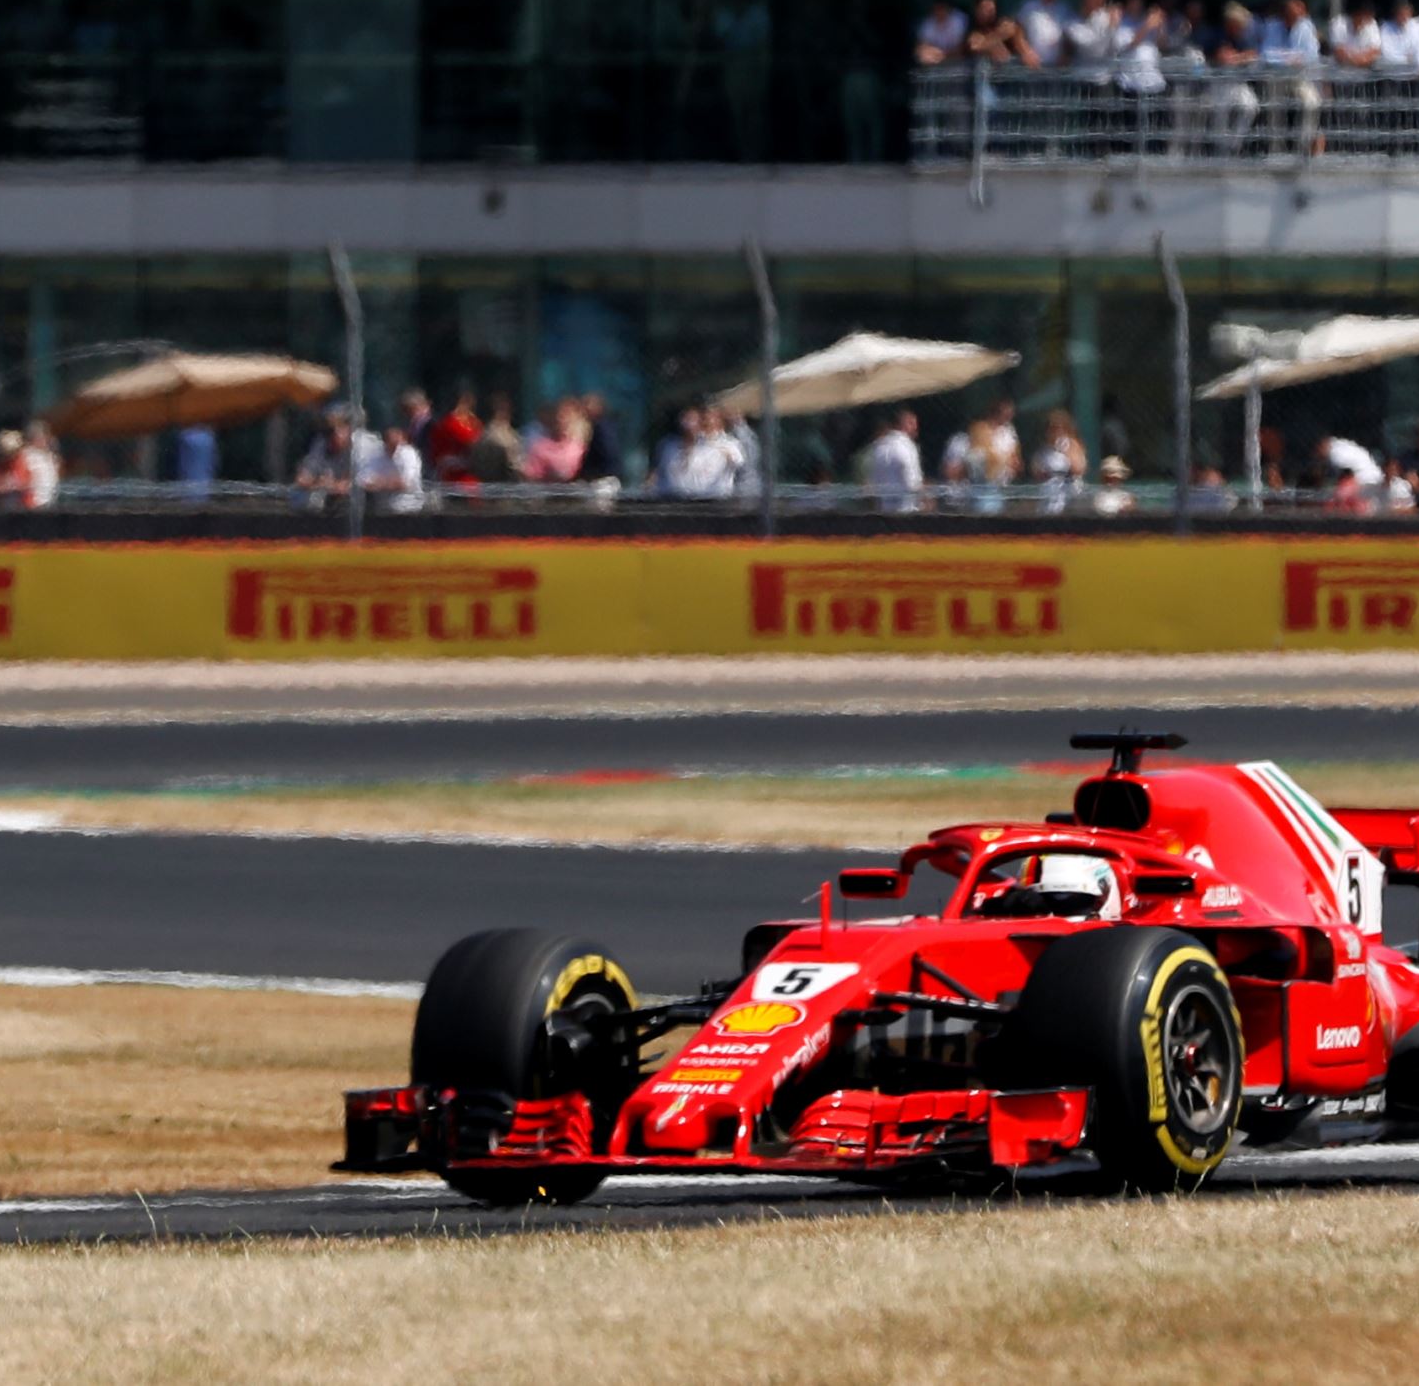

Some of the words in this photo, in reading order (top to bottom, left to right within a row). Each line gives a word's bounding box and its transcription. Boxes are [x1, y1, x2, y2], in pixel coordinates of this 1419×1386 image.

[228, 565, 539, 640] PIRELLI
[748, 561, 1064, 637] PIRELLI
[1348, 856, 1362, 925] 5
[772, 968, 822, 995] 5
[1316, 1023, 1361, 1050] Lenovo
[652, 1081, 734, 1094] MAHLE
